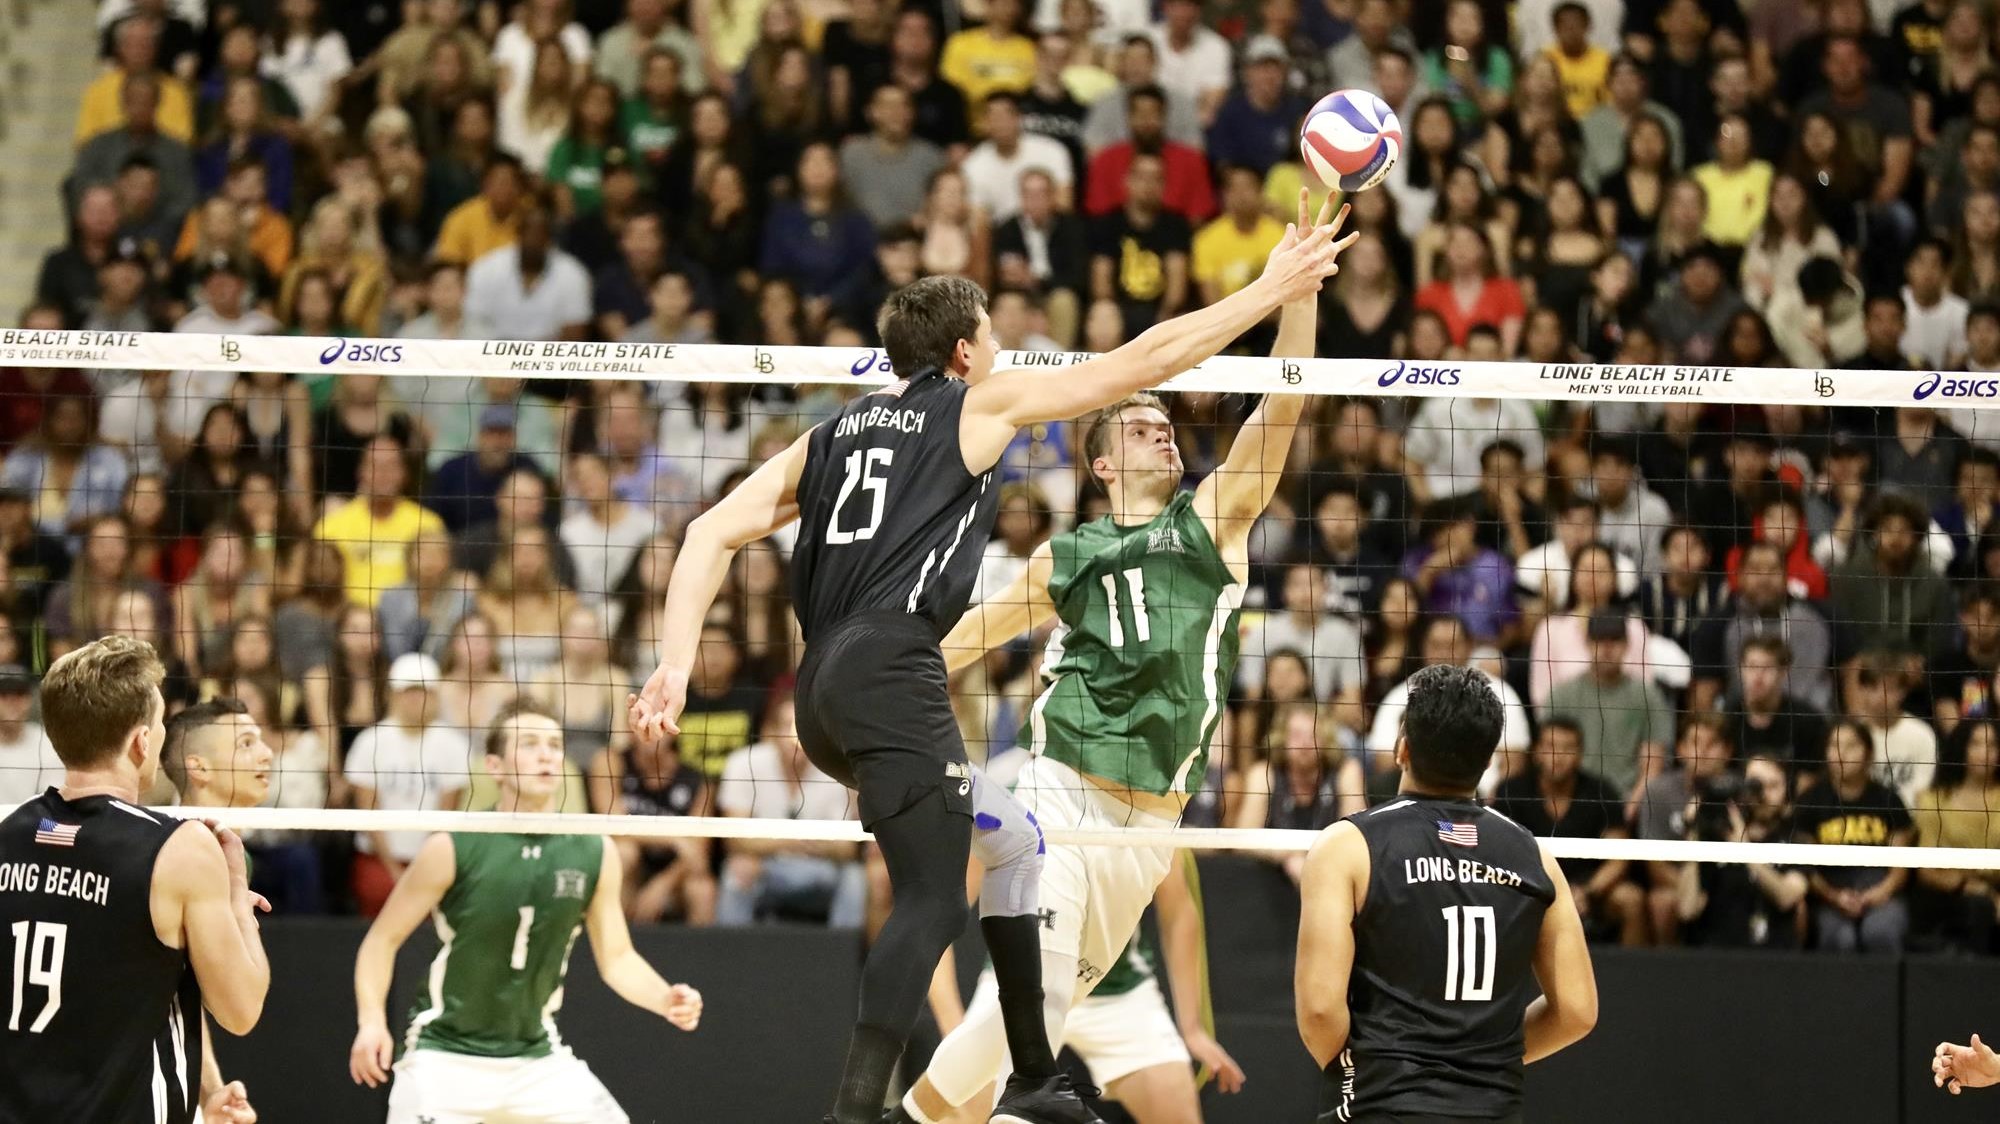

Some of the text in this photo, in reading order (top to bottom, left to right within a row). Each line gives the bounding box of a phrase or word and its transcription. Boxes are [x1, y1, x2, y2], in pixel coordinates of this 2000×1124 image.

[3, 330, 142, 347] BEACH STATE
[482, 341, 678, 359] LONG BEACH STATE
[21, 349, 109, 361] VOLLEYBALL
[510, 360, 645, 373] MEN'S VOLLEYBALL
[1011, 351, 1063, 366] LONG
[1540, 365, 1737, 382] LONG BEACH STATE
[1568, 384, 1704, 396] MEN'S VOLLEYBALL
[866, 406, 926, 434] BEACH
[826, 447, 894, 545] 25
[1101, 567, 1151, 647] 11
[0, 862, 110, 906] ONG BEACH
[1404, 857, 1522, 887] LONG BEACH
[510, 905, 535, 970] 1
[1441, 905, 1497, 1001] 10
[8, 920, 68, 1034] 19
